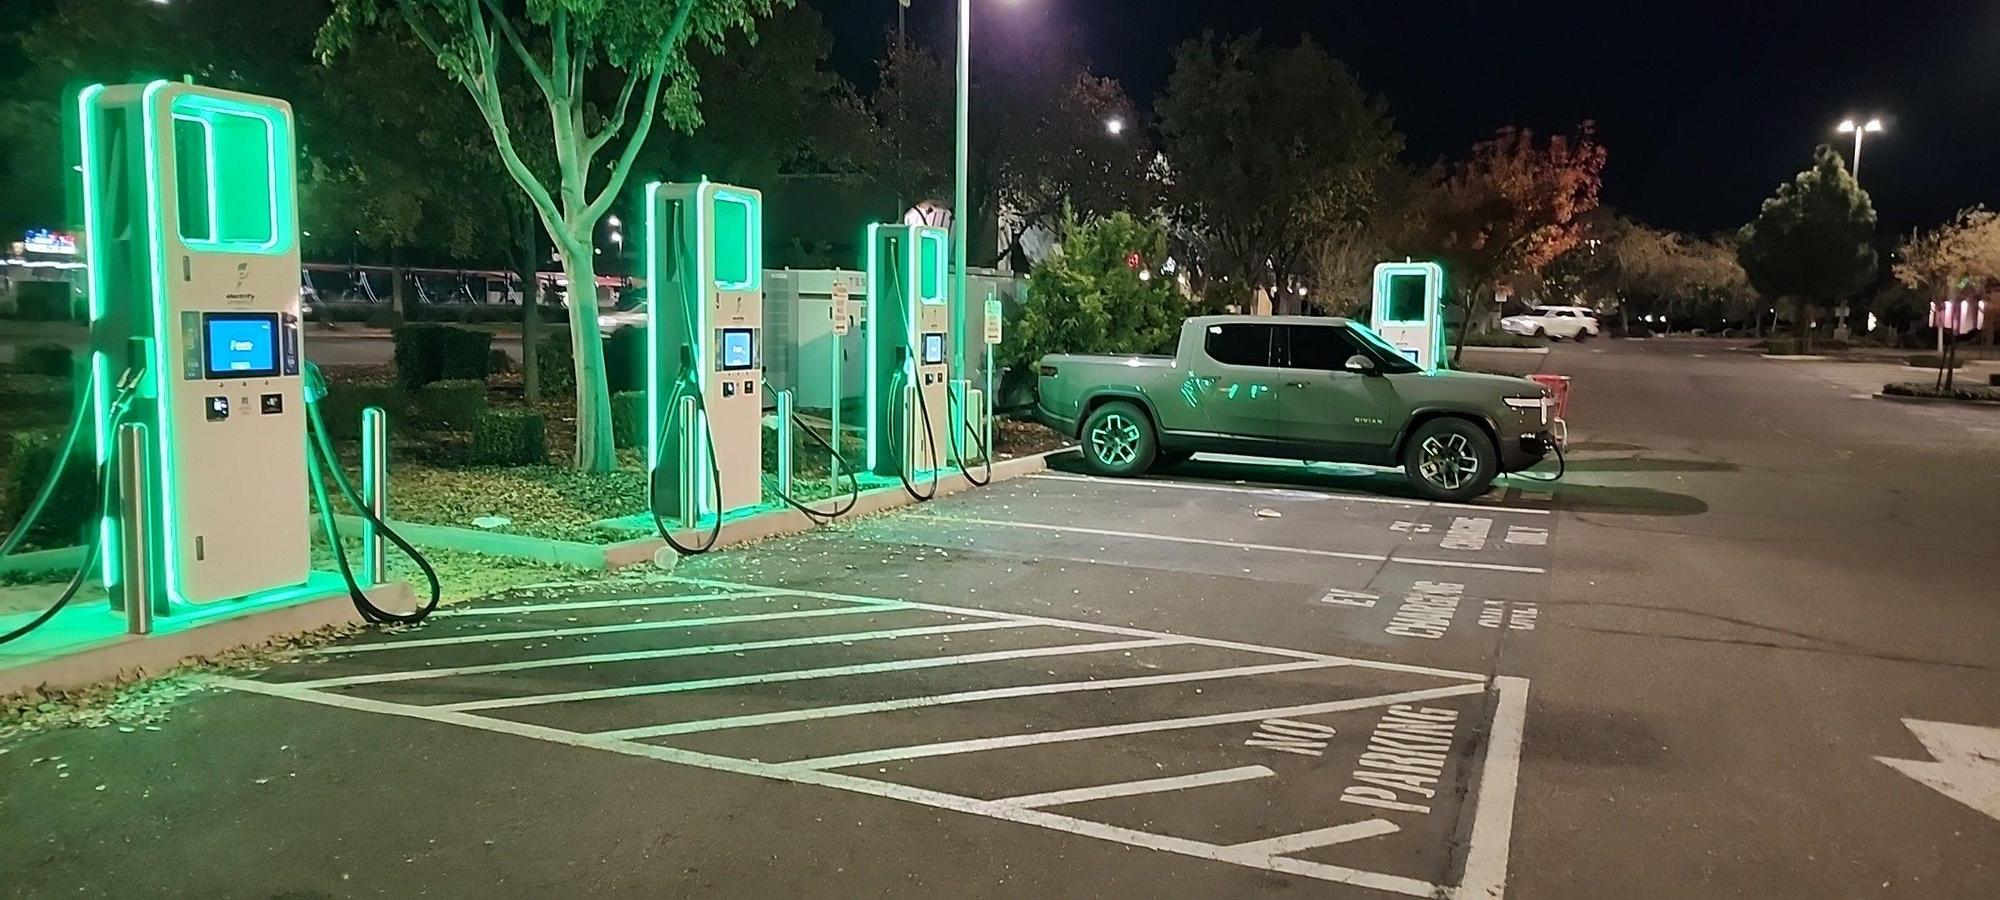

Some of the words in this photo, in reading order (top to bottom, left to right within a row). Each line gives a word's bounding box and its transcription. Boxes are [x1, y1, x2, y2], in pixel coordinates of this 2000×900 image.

[1354, 417, 1383, 425] RIVIAN
[1321, 588, 1380, 608] EV
[1385, 580, 1465, 639] CHARGING
[1244, 718, 1337, 757] NO
[1340, 704, 1460, 815] PARKING
